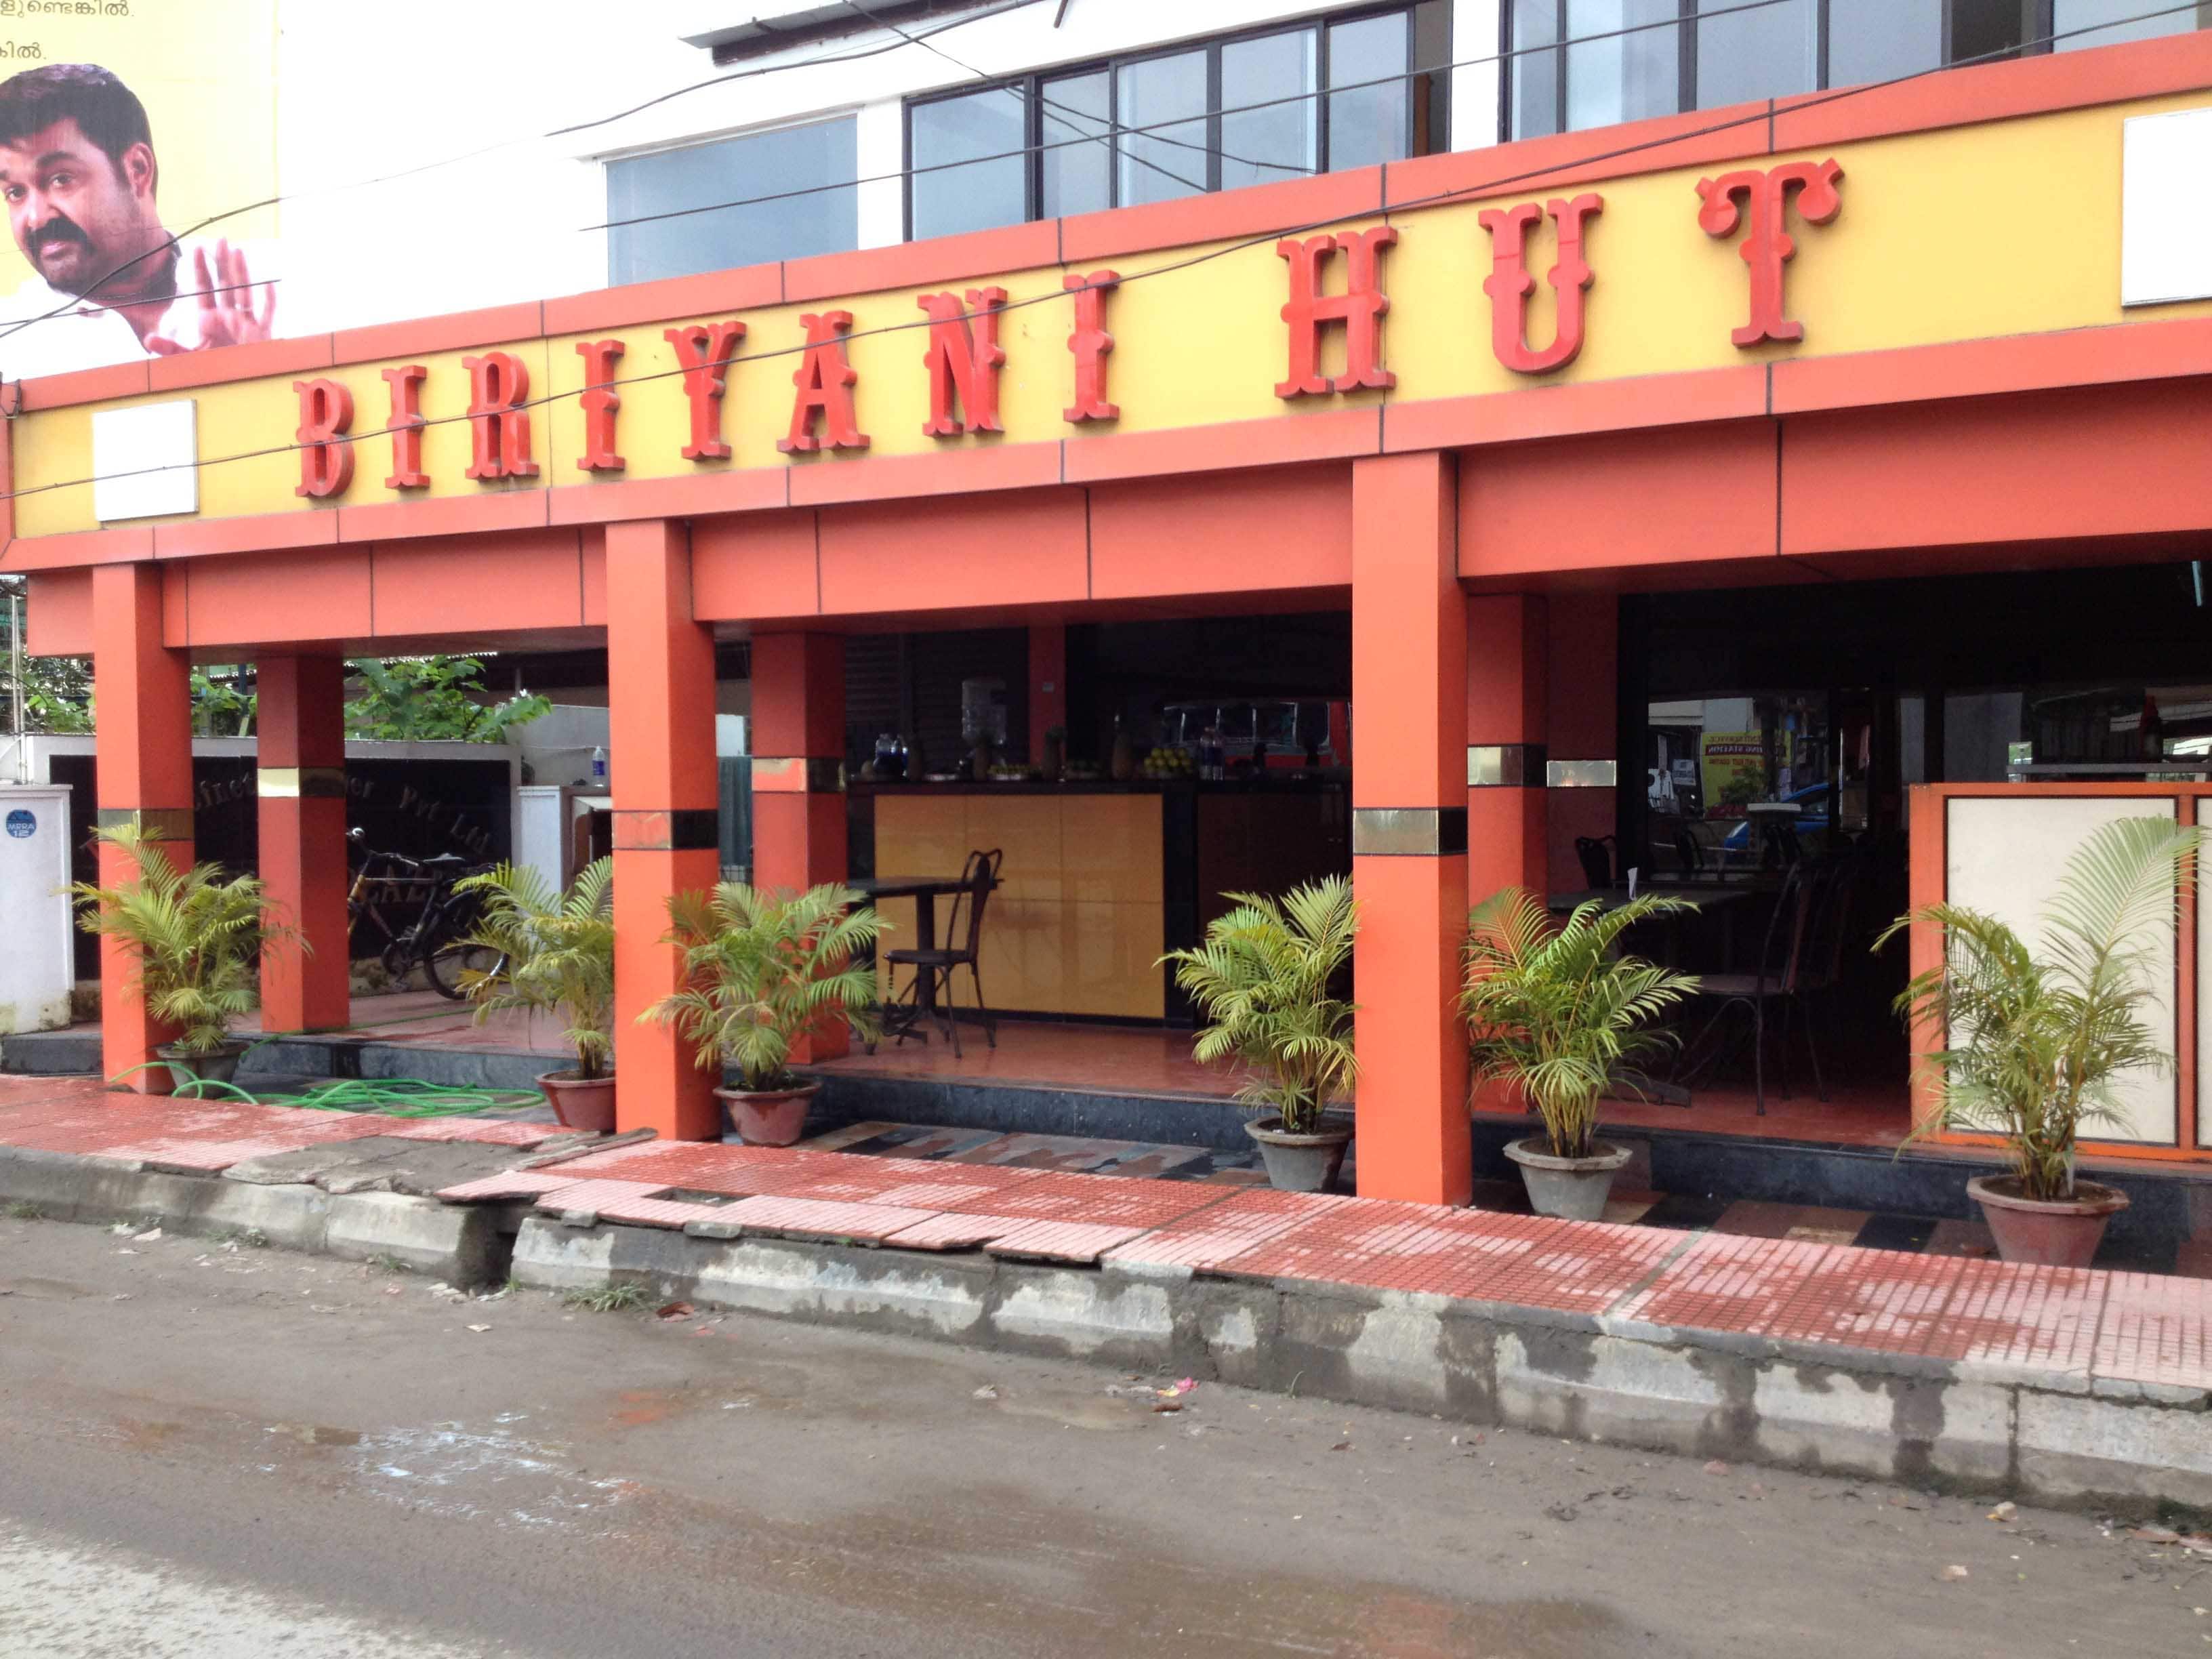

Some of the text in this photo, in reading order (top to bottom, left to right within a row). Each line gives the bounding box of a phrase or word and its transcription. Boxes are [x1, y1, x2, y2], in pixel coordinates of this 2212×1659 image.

[292, 158, 1844, 499] BIRIYANI HUT
[450, 813, 490, 853] Ltd
